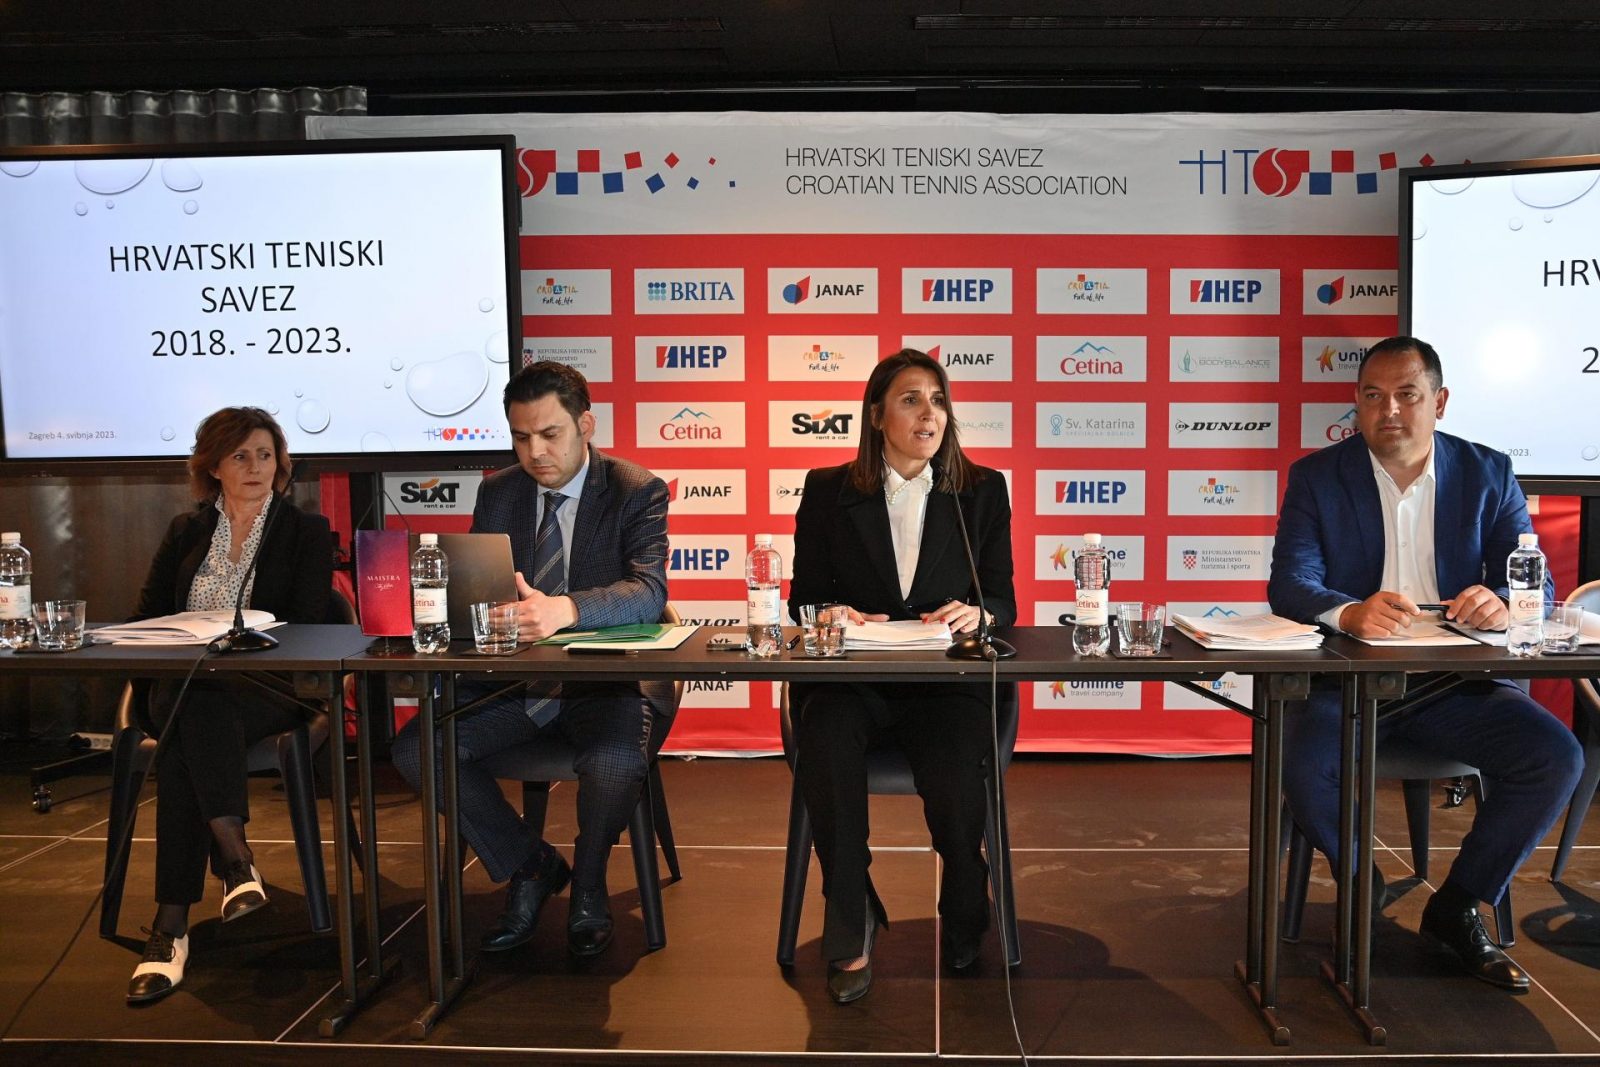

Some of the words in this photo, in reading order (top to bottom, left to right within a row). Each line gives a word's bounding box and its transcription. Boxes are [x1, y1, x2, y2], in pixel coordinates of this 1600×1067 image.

[785, 148, 887, 168] HRVATSKI
[893, 148, 971, 167] TENISKI
[979, 149, 1044, 168] SAVEZ
[785, 175, 894, 195] CROATIAN
[900, 175, 978, 195] TENNIS
[984, 175, 1128, 195] ASSOCIATION
[109, 243, 255, 272] HRVATSKI
[265, 239, 384, 269] TENISKI
[200, 285, 297, 313] SAVEZ
[669, 281, 735, 301] BRITA
[815, 284, 865, 298] JANAF
[947, 279, 994, 302] HEP
[1214, 279, 1262, 303] HEP
[1349, 284, 1398, 299] JANAF
[150, 329, 236, 358] 2018.
[266, 326, 352, 355] 2023.
[680, 345, 727, 368] HEP
[945, 354, 995, 367] JANAF
[1060, 357, 1123, 375] Cetina
[659, 422, 722, 441] Cetina
[1065, 418, 1082, 429] Sv.
[1086, 417, 1135, 429] Katarina
[1190, 421, 1272, 431] DUNLOP
[28, 431, 56, 441] Zagreb
[66, 431, 94, 441] svibnja
[683, 485, 732, 500] JANAF
[1079, 480, 1127, 503] HEP
[684, 548, 730, 571] HEP
[680, 618, 741, 626] UNLOP
[687, 680, 734, 693] JANAF
[1091, 690, 1125, 698] company
